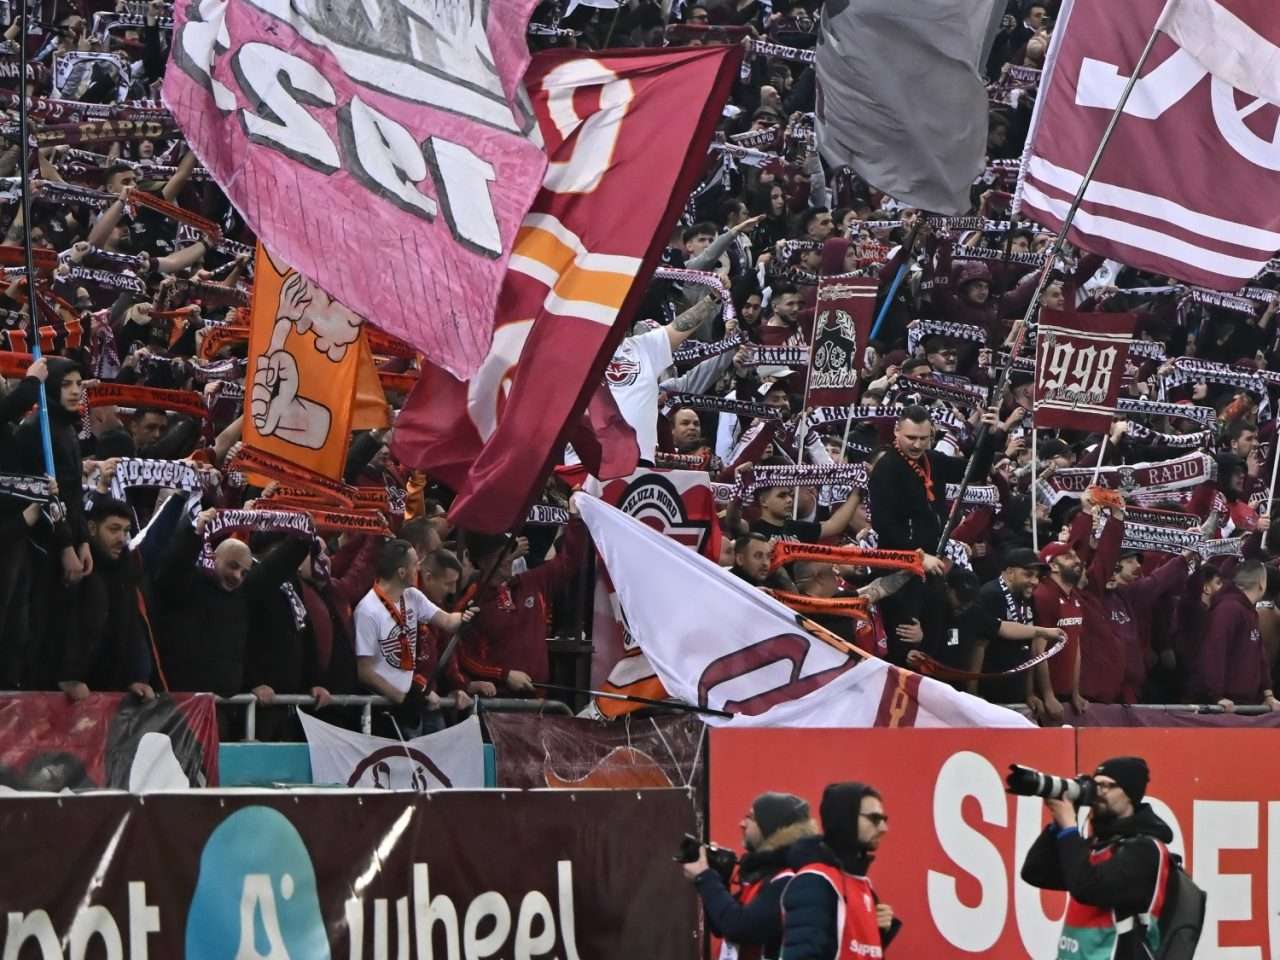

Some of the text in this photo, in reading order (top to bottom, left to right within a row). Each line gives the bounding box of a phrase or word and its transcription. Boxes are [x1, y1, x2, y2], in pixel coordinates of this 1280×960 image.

[78, 121, 162, 141] RAPID
[758, 347, 801, 362] RAPID
[1040, 341, 1118, 392] 1998
[1149, 458, 1199, 486] RAPID
